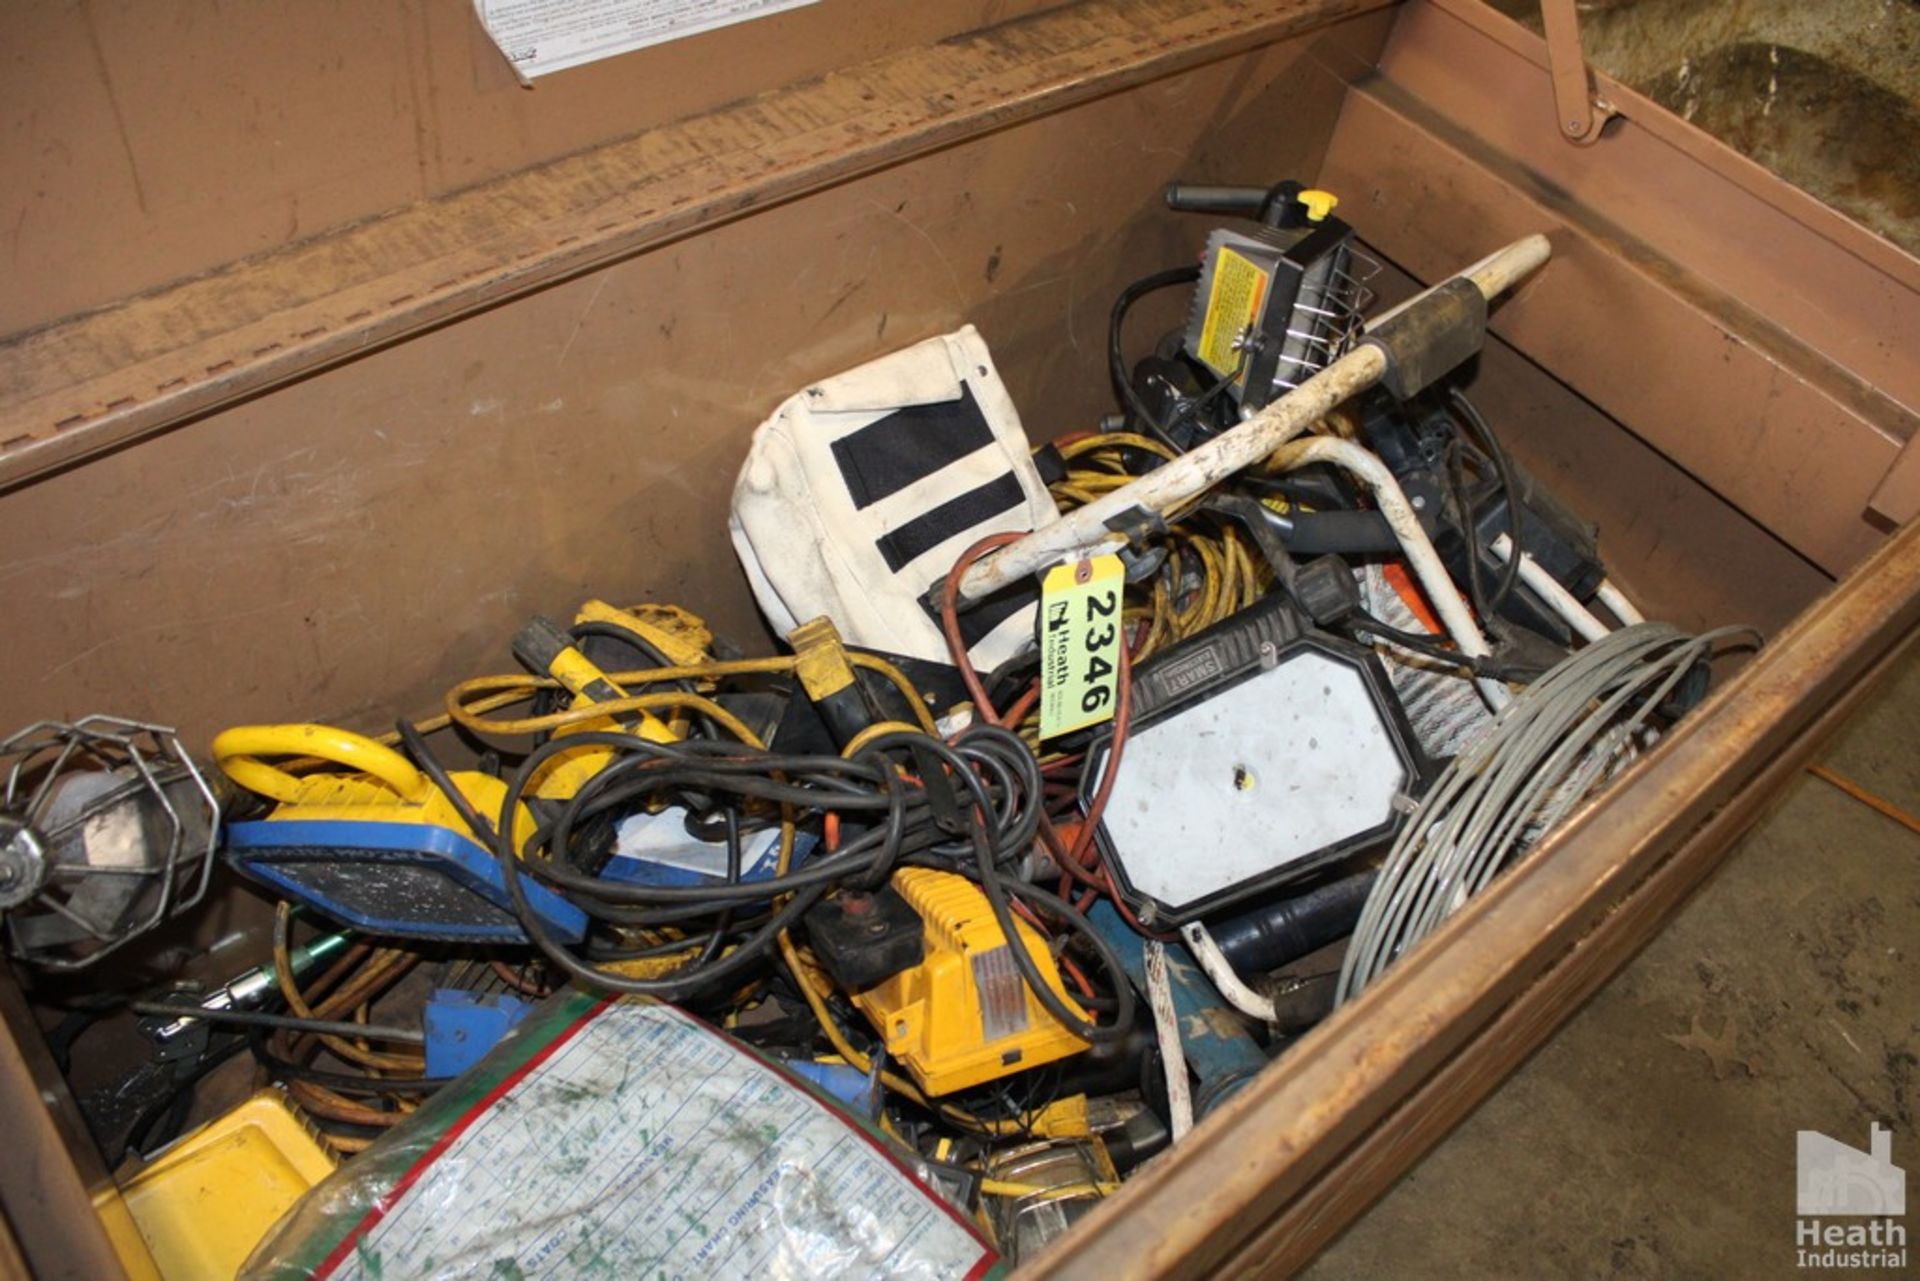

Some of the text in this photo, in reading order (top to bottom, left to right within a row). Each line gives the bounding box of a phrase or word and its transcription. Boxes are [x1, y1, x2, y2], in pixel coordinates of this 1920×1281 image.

[1056, 629, 1070, 686] Heath
[1081, 590, 1117, 713] 2346
[1167, 660, 1216, 691] SMART
[525, 1228, 568, 1269] COATS
[692, 1226, 728, 1266] CHART
